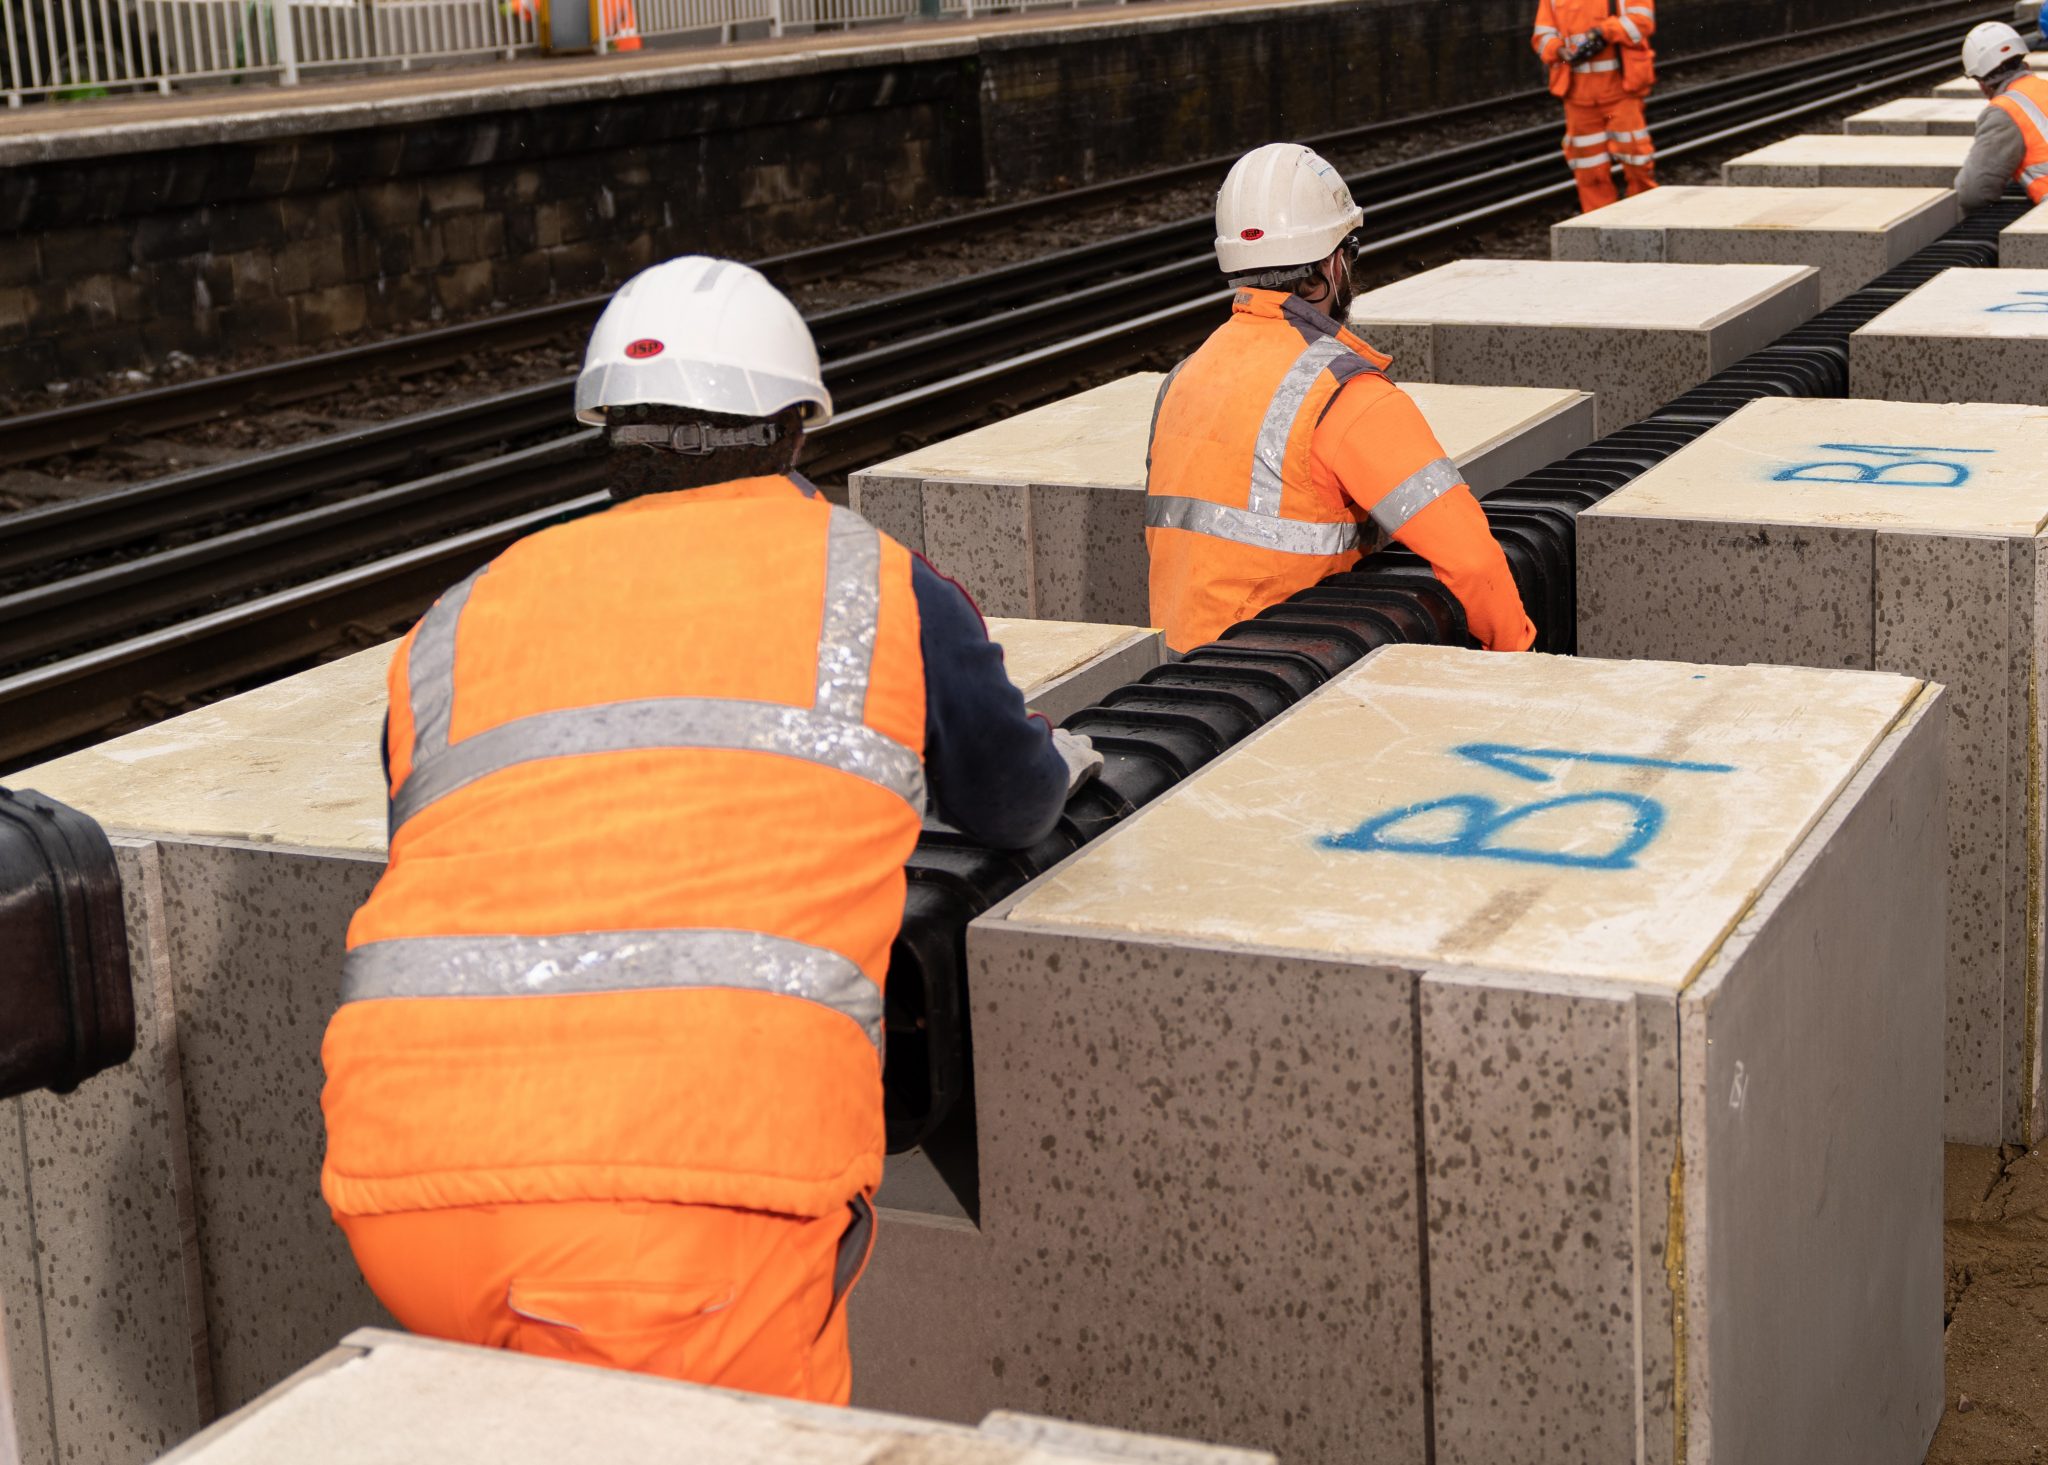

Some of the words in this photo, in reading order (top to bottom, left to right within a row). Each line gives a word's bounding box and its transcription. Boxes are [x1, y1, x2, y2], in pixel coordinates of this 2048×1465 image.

[632, 341, 659, 355] JSP
[1771, 443, 1996, 487] B1
[1314, 743, 1736, 869] B1
